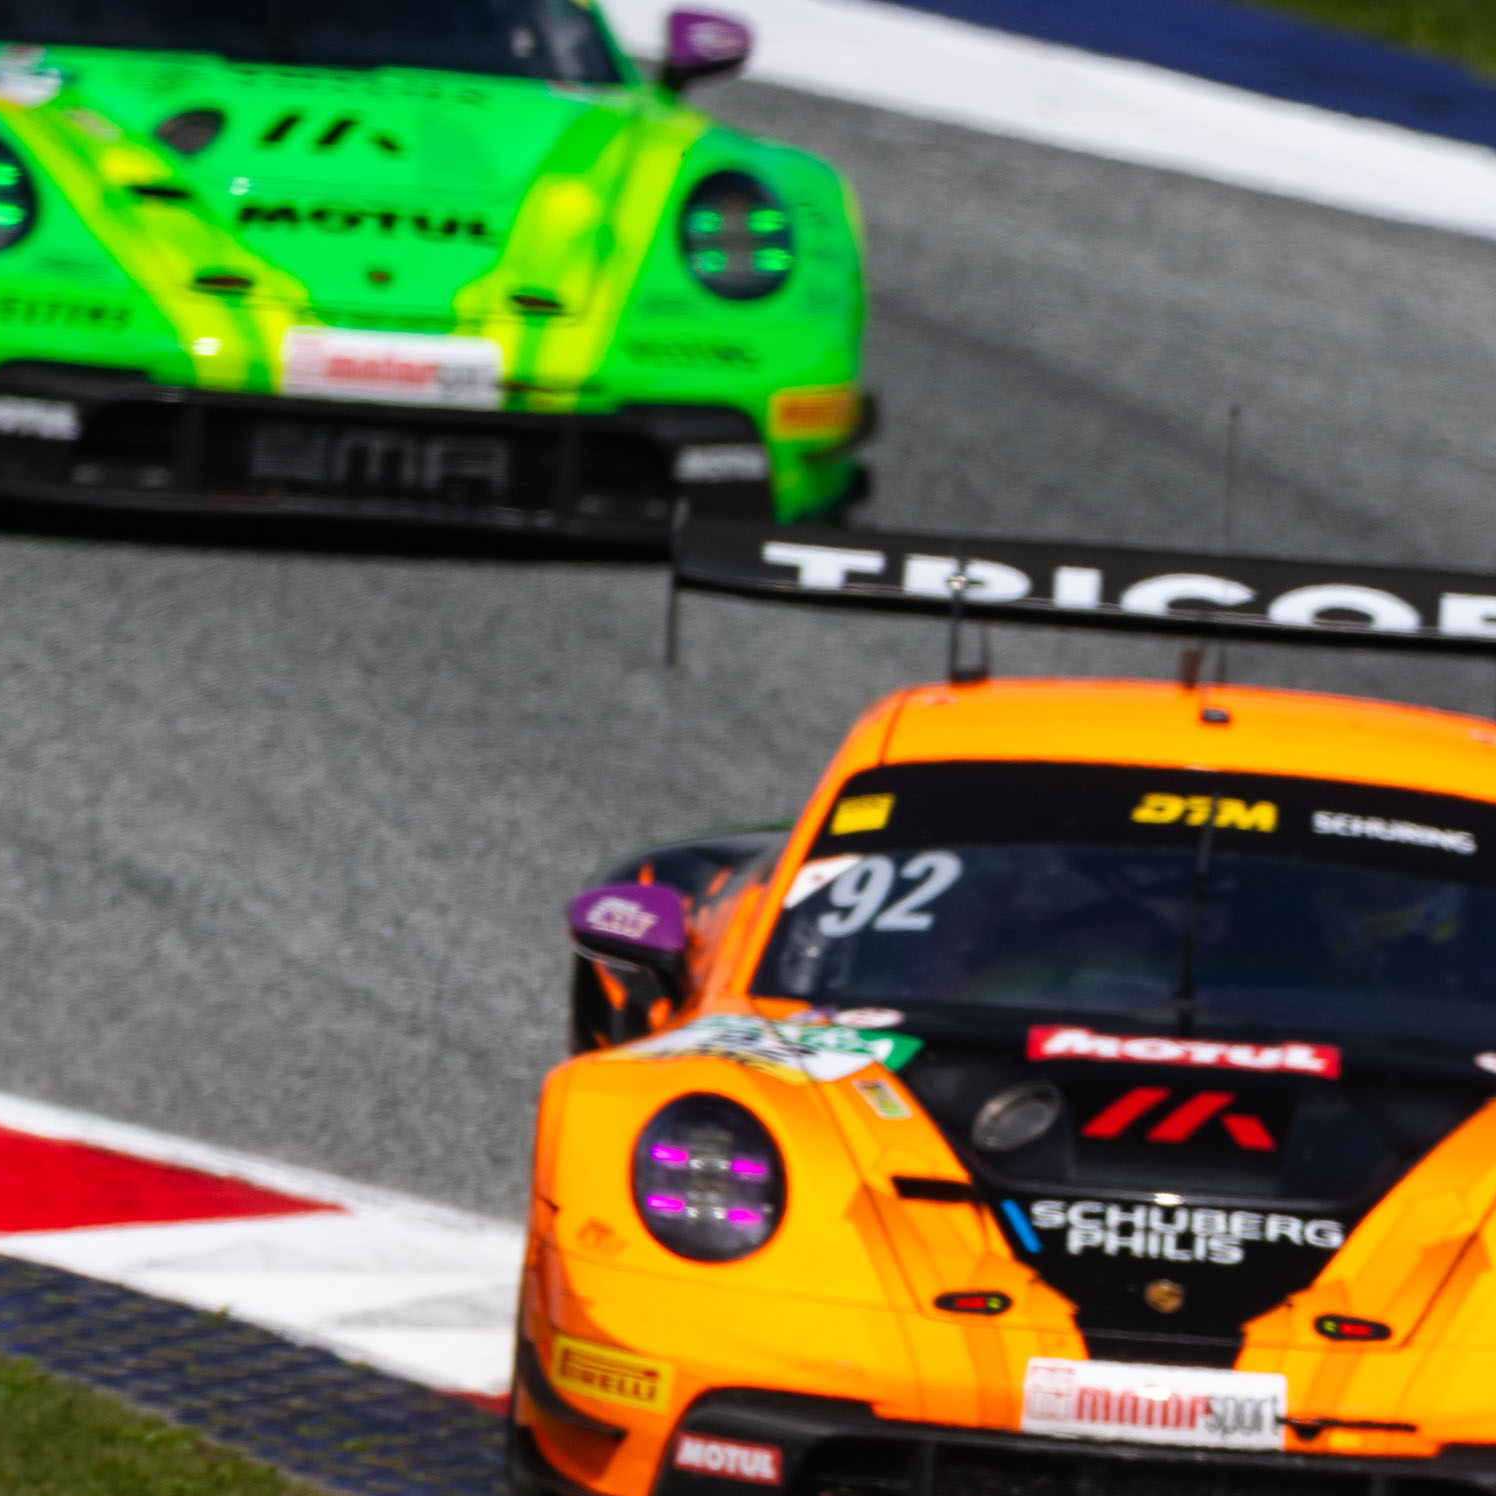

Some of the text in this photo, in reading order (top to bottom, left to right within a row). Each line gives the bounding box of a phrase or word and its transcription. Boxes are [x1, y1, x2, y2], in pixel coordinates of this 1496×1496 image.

[237, 205, 500, 246] MOTUL
[1131, 793, 1278, 833] DTM
[817, 850, 964, 938] 92
[1042, 1028, 1327, 1072] MOTUL
[1029, 1200, 1345, 1249] SCHUBERG
[1066, 1229, 1245, 1265] PHILIS
[675, 1437, 778, 1480] MOTUL
